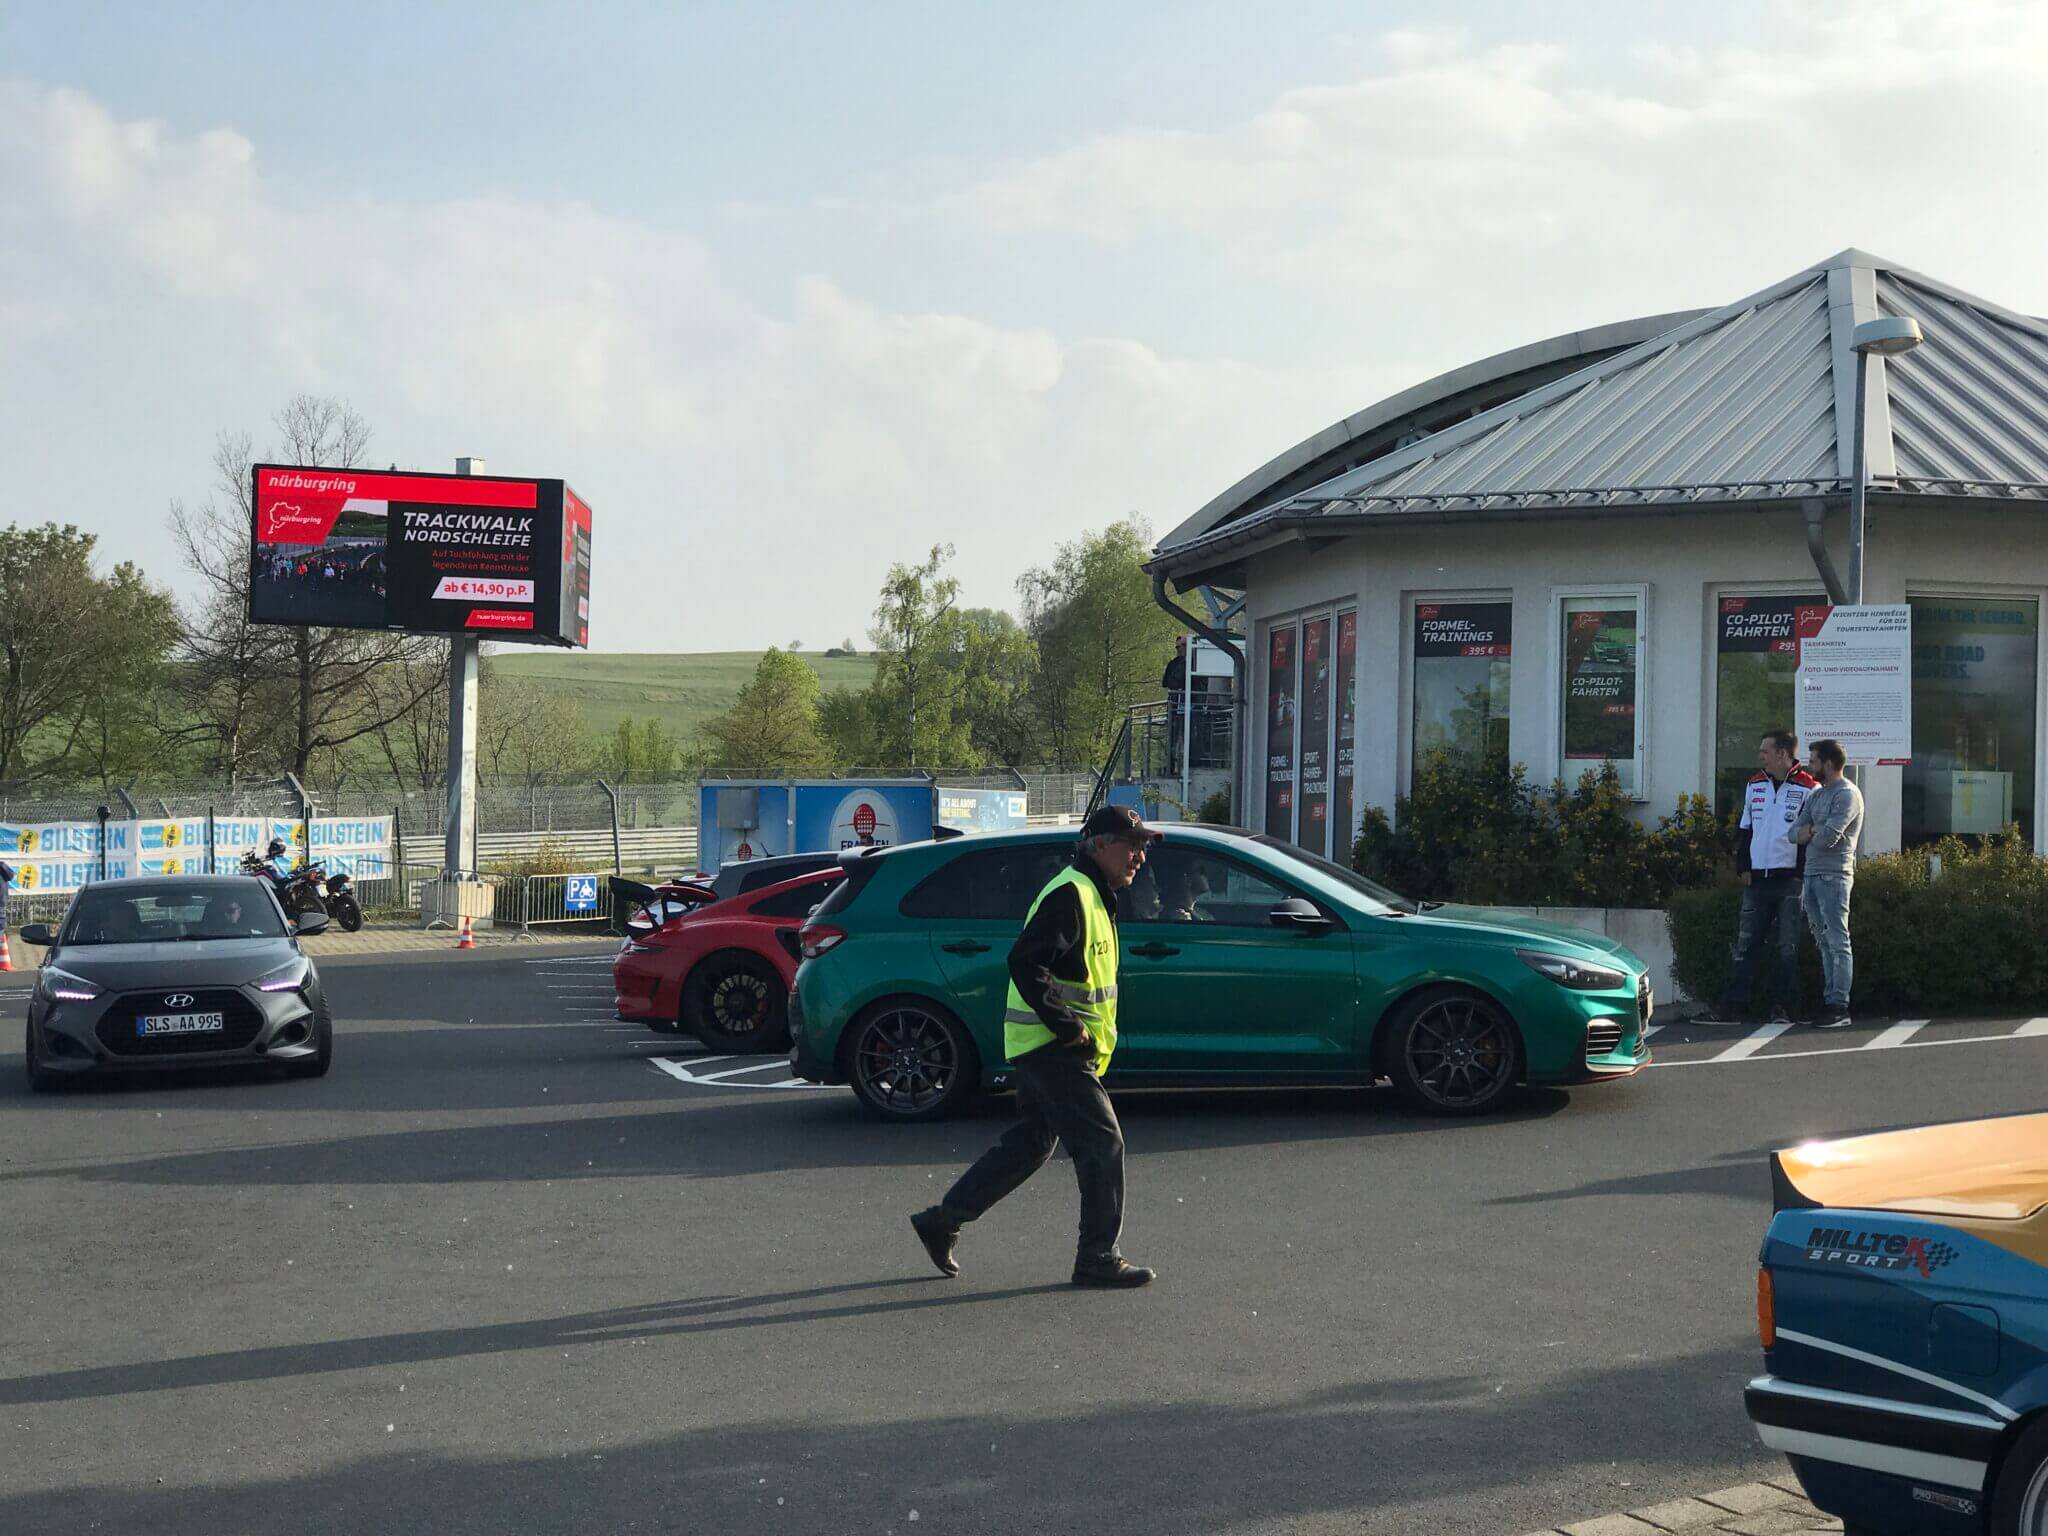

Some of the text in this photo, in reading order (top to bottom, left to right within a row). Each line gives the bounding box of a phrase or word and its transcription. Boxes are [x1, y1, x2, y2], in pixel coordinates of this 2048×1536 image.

[269, 475, 356, 493] nürburgring
[280, 516, 322, 525] nürburgring
[403, 511, 533, 532] TRACKWALK
[404, 529, 532, 547] NORDSCHLEIFE
[444, 582, 528, 598] ab € 14,90 p.P.
[1423, 620, 1476, 631] FORMEL-
[1726, 613, 1796, 625] CO-PILOT-
[1423, 631, 1493, 642] TRAININGS
[1726, 625, 1790, 637] FAHRTEN
[1468, 646, 1486, 656] 395
[1572, 677, 1623, 686] CO-PILOT-
[1572, 687, 1619, 697] FAHRTEN
[41, 827, 126, 851] BILSTEIN
[184, 823, 259, 846] BILSTEIN
[311, 822, 383, 846] BILSTEIN
[841, 840, 889, 851] FRAEN
[184, 856, 241, 876] BILSTE
[571, 880, 580, 898] P
[146, 1015, 221, 1031] SLS AA 995
[1807, 1227, 1932, 1279] MILLTEK
[1809, 1250, 1899, 1268] SPORT
